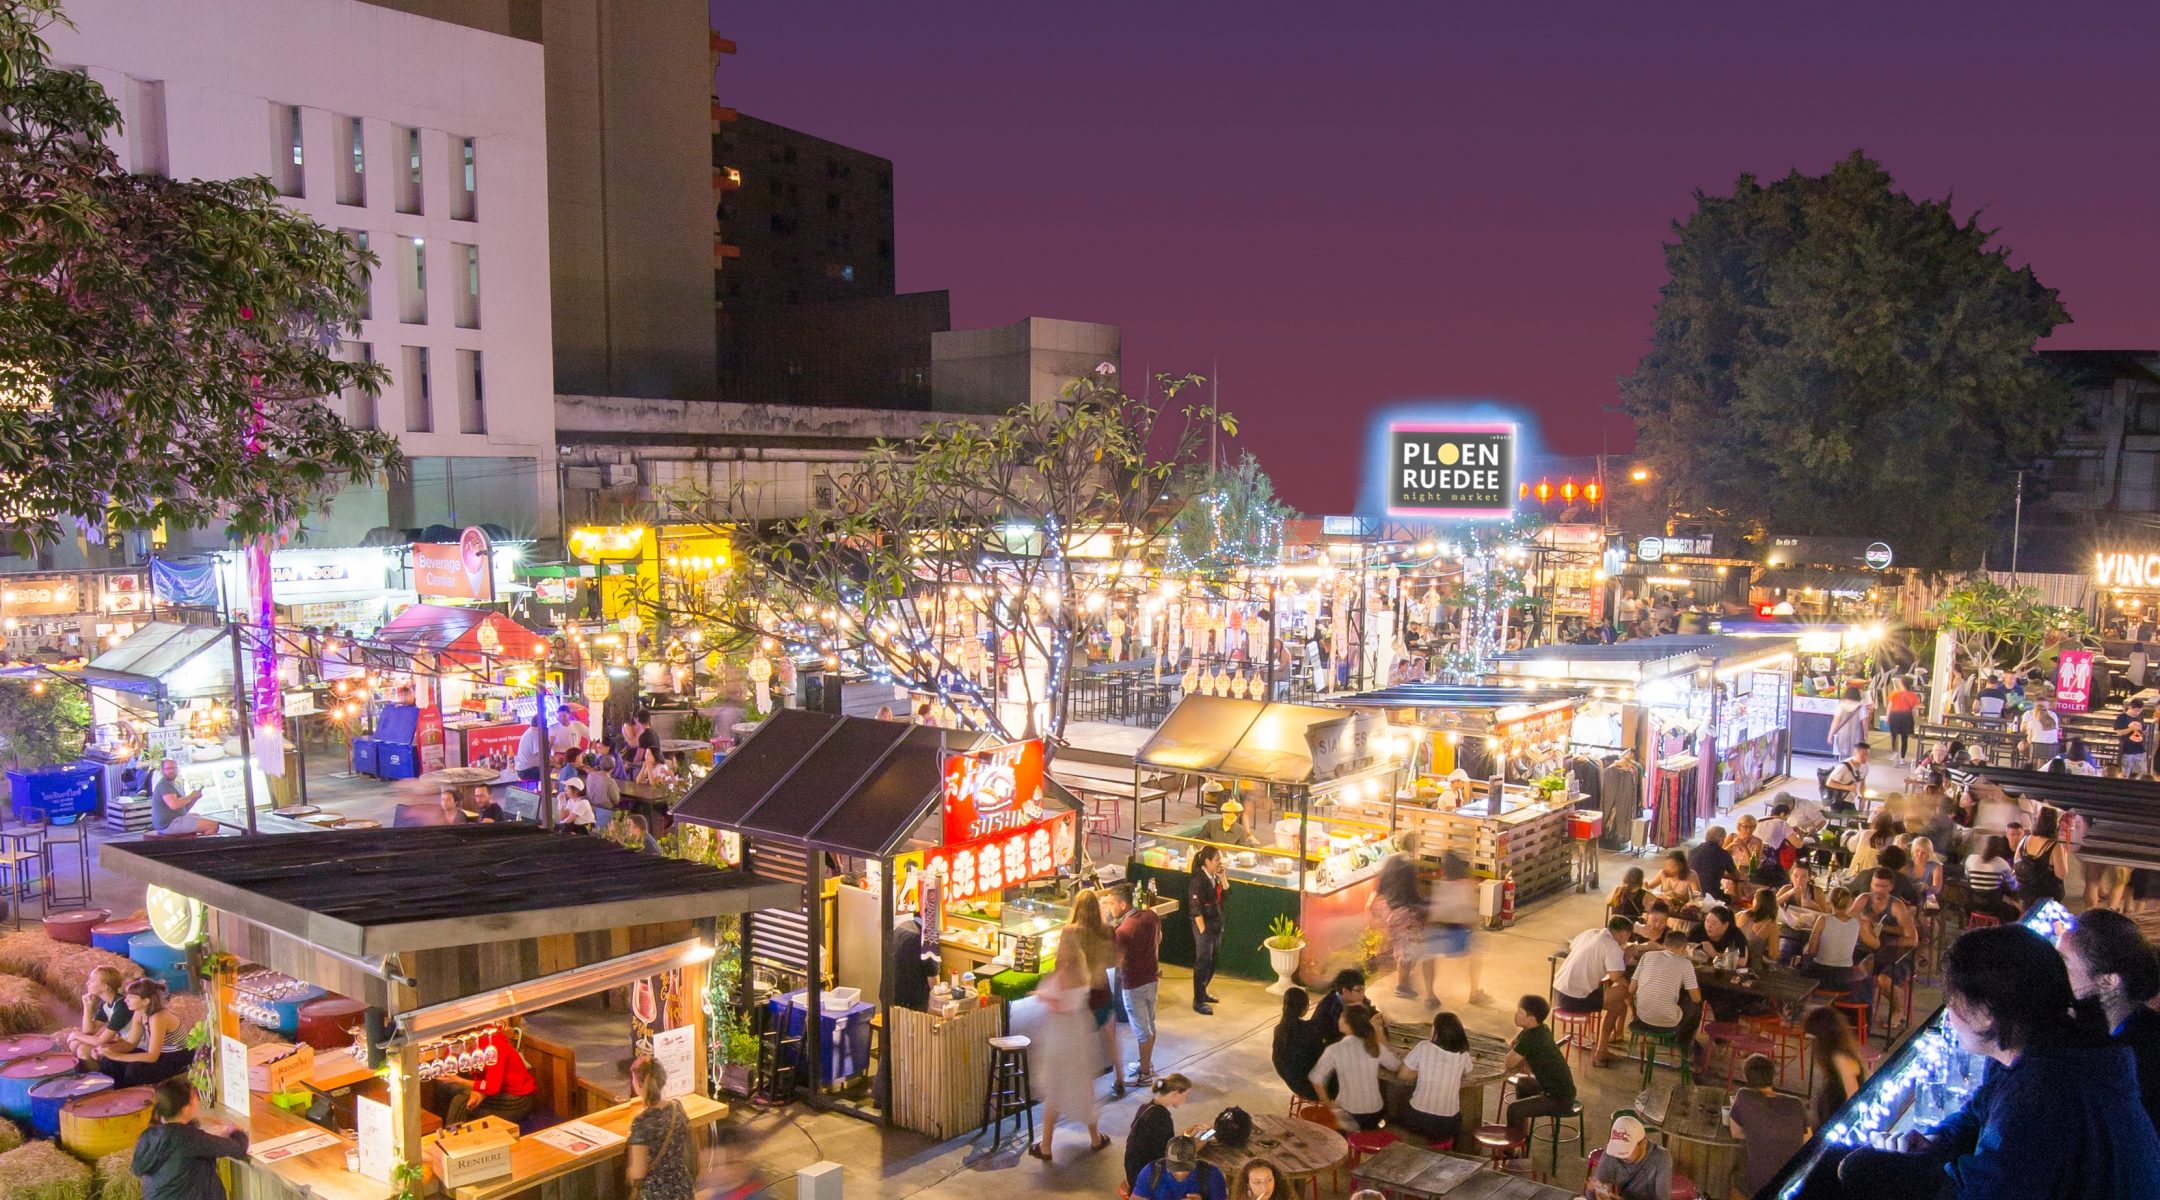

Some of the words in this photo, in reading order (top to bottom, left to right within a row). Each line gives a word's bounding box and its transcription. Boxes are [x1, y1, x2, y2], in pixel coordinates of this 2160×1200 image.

[1403, 442, 1499, 466] PLOEN
[1403, 469, 1500, 489] RUEDEE
[1403, 492, 1442, 502] night
[1451, 493, 1499, 502] market
[1663, 538, 1694, 554] BURGER
[1695, 539, 1712, 555] BOX
[418, 554, 462, 572] Beverage
[425, 571, 457, 586] Center
[14, 588, 51, 604] BBQ
[2056, 702, 2086, 711] TOILET
[969, 809, 1022, 838] SUSHI
[458, 1152, 502, 1169] RENIERI
